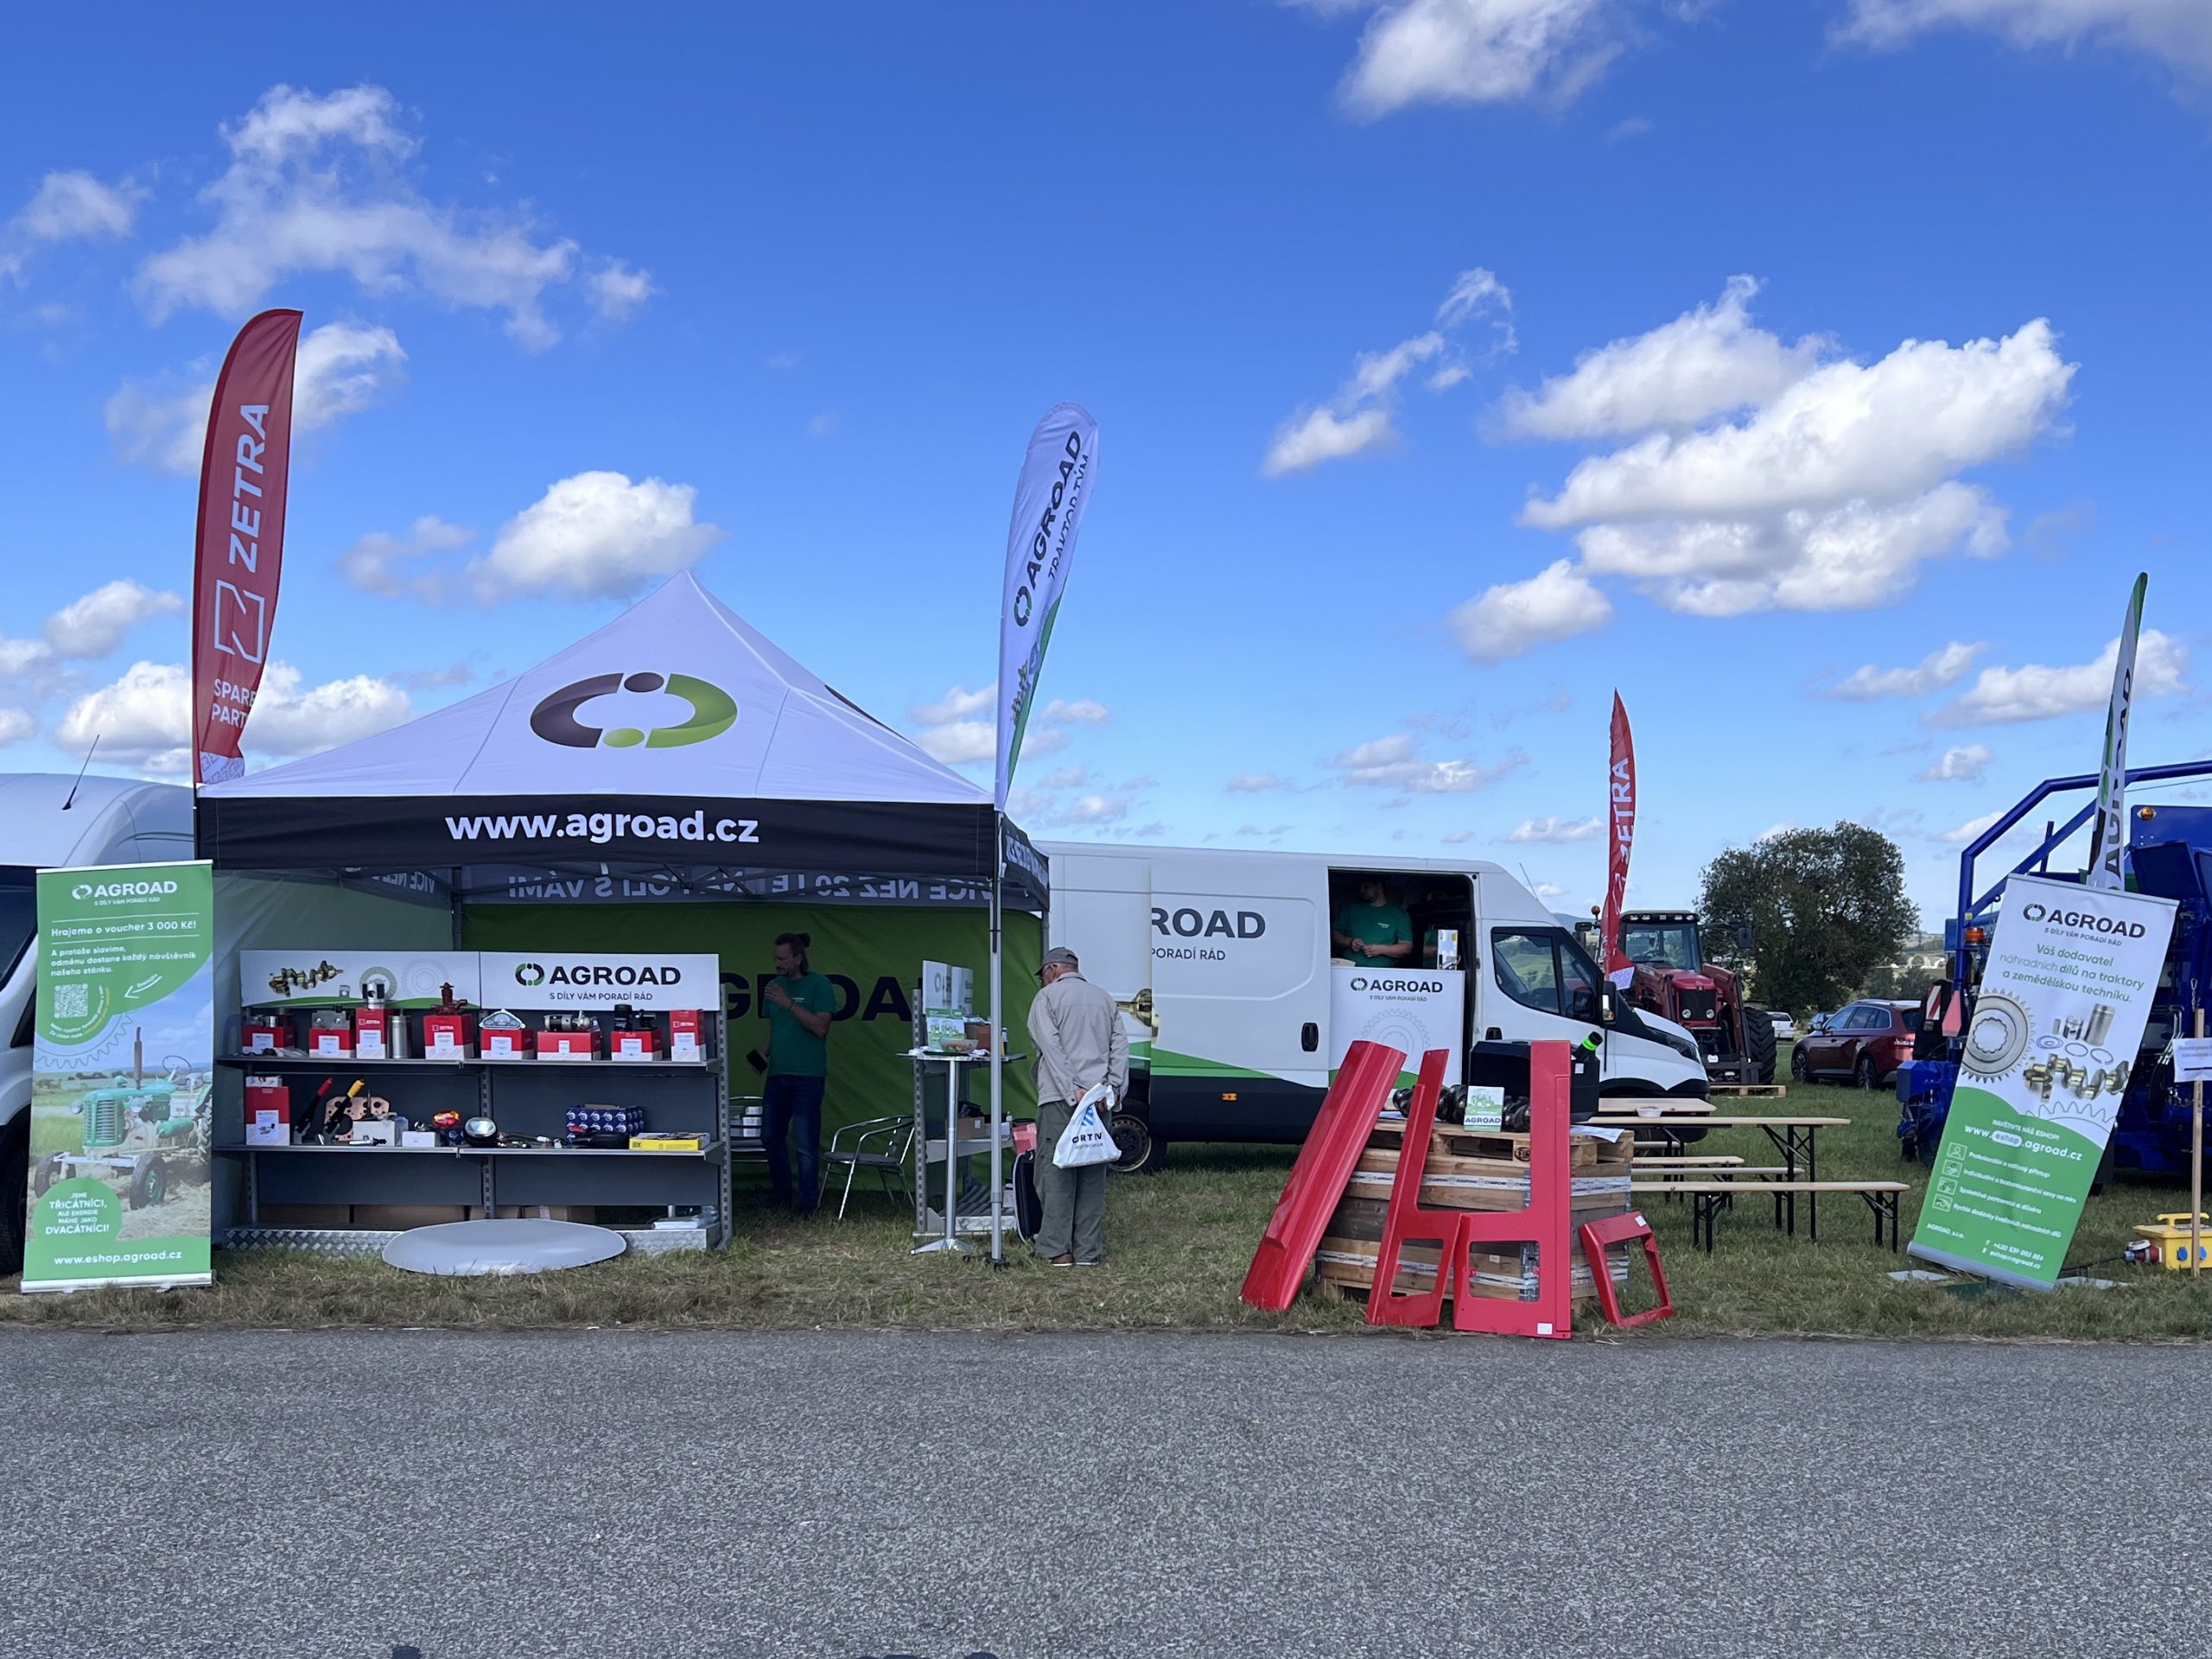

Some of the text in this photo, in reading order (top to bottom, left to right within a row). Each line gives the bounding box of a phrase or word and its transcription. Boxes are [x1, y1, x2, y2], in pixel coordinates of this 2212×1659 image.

[229, 404, 269, 573] ZETRA
[1027, 430, 1082, 590] AGROAD
[212, 702, 248, 729] PART
[445, 810, 760, 844] www.agroad.cz
[94, 880, 177, 898] AGROAD
[51, 928, 92, 938] Hrajeme
[105, 923, 144, 933] voucher
[156, 921, 178, 930] 000
[181, 920, 196, 929] Kč!
[2047, 909, 2145, 938] AGROAD
[2080, 933, 2107, 944] PORADÍ
[60, 946, 91, 957] protože
[86, 955, 120, 964] dostane
[122, 952, 146, 963] každý
[149, 951, 197, 961] návštěvník
[1200, 948, 1225, 961] RÁD
[2037, 944, 2114, 967] Váš dodavatel
[51, 968, 81, 976] našeho
[549, 966, 681, 985] AGROAD
[1999, 954, 2145, 990] náhradních dílů na traktory
[1370, 979, 1443, 993] AGROAD
[2012, 970, 2080, 992] zemědělskou
[2082, 984, 2133, 1002] techniku.
[557, 991, 575, 1001] DÍLY
[577, 991, 596, 1001] VÁM
[598, 991, 632, 1001] PORADÍ
[634, 992, 653, 1001] RÁD
[49, 1198, 107, 1210] TŘICÁTNÍCI,
[45, 1224, 110, 1235] DVACÁTNÍCI!
[54, 1250, 182, 1265] www.eshop.agroad.cz
